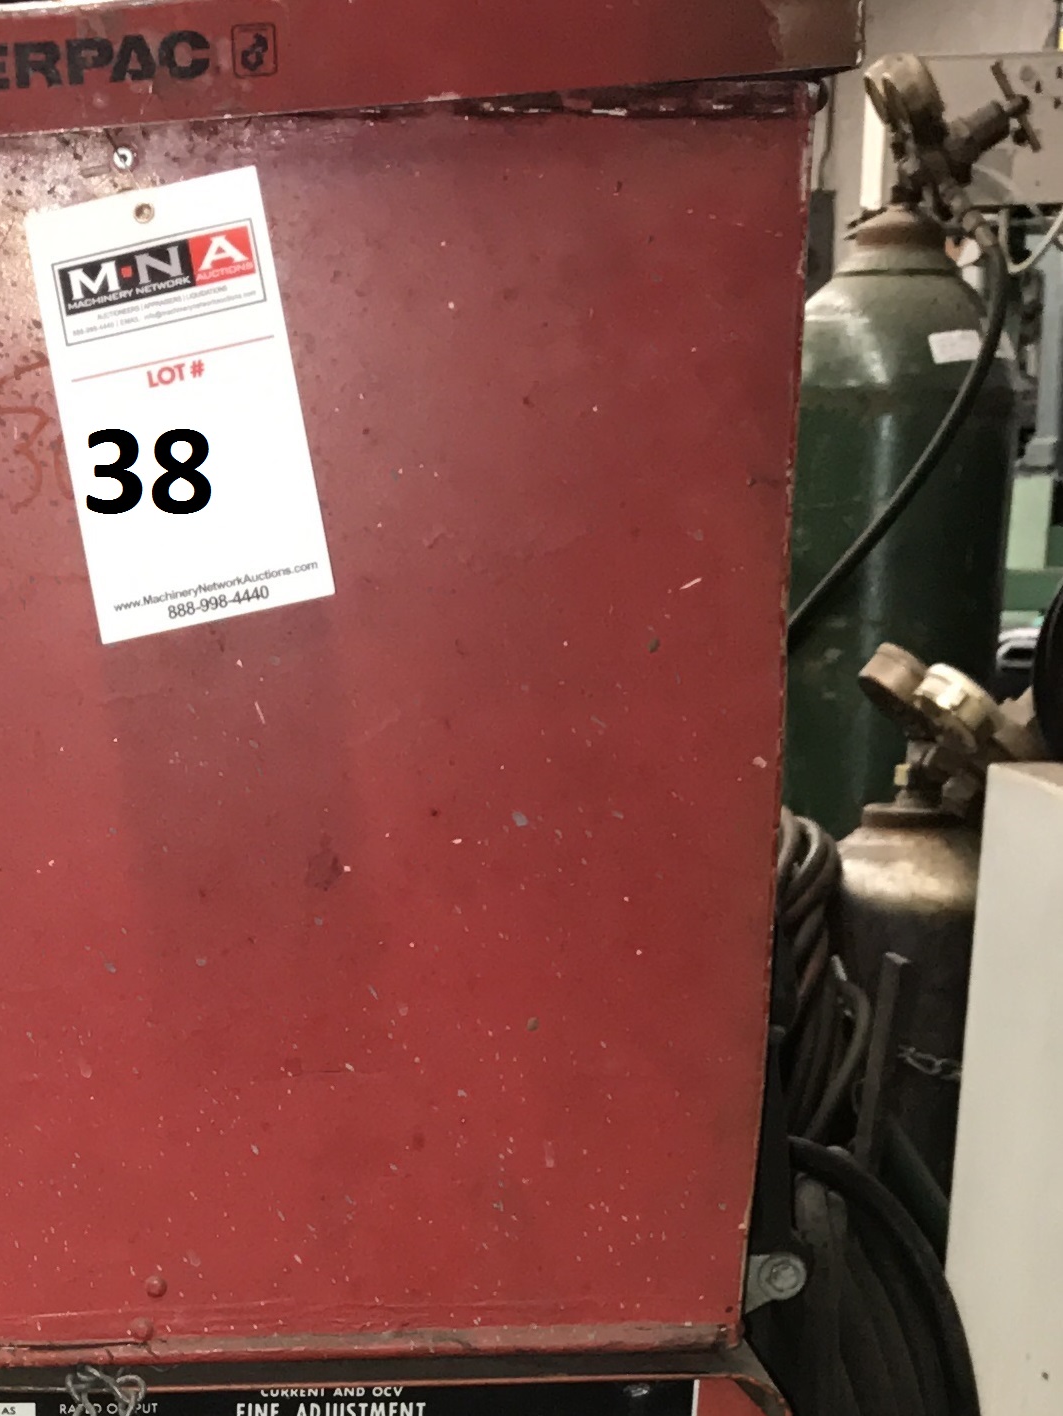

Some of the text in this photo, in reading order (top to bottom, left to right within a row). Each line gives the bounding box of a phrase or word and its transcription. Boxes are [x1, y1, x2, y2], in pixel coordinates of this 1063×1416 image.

[195, 261, 254, 282] AUCTIONS
[68, 275, 191, 311] MACHINERY NETWORK
[147, 359, 205, 388] LOT #
[114, 561, 318, 612] www.MachineryNetworkAuctions.com
[167, 585, 269, 619] 888-998-4440
[333, 1387, 366, 1397] AND
[372, 1386, 404, 1397] OCV
